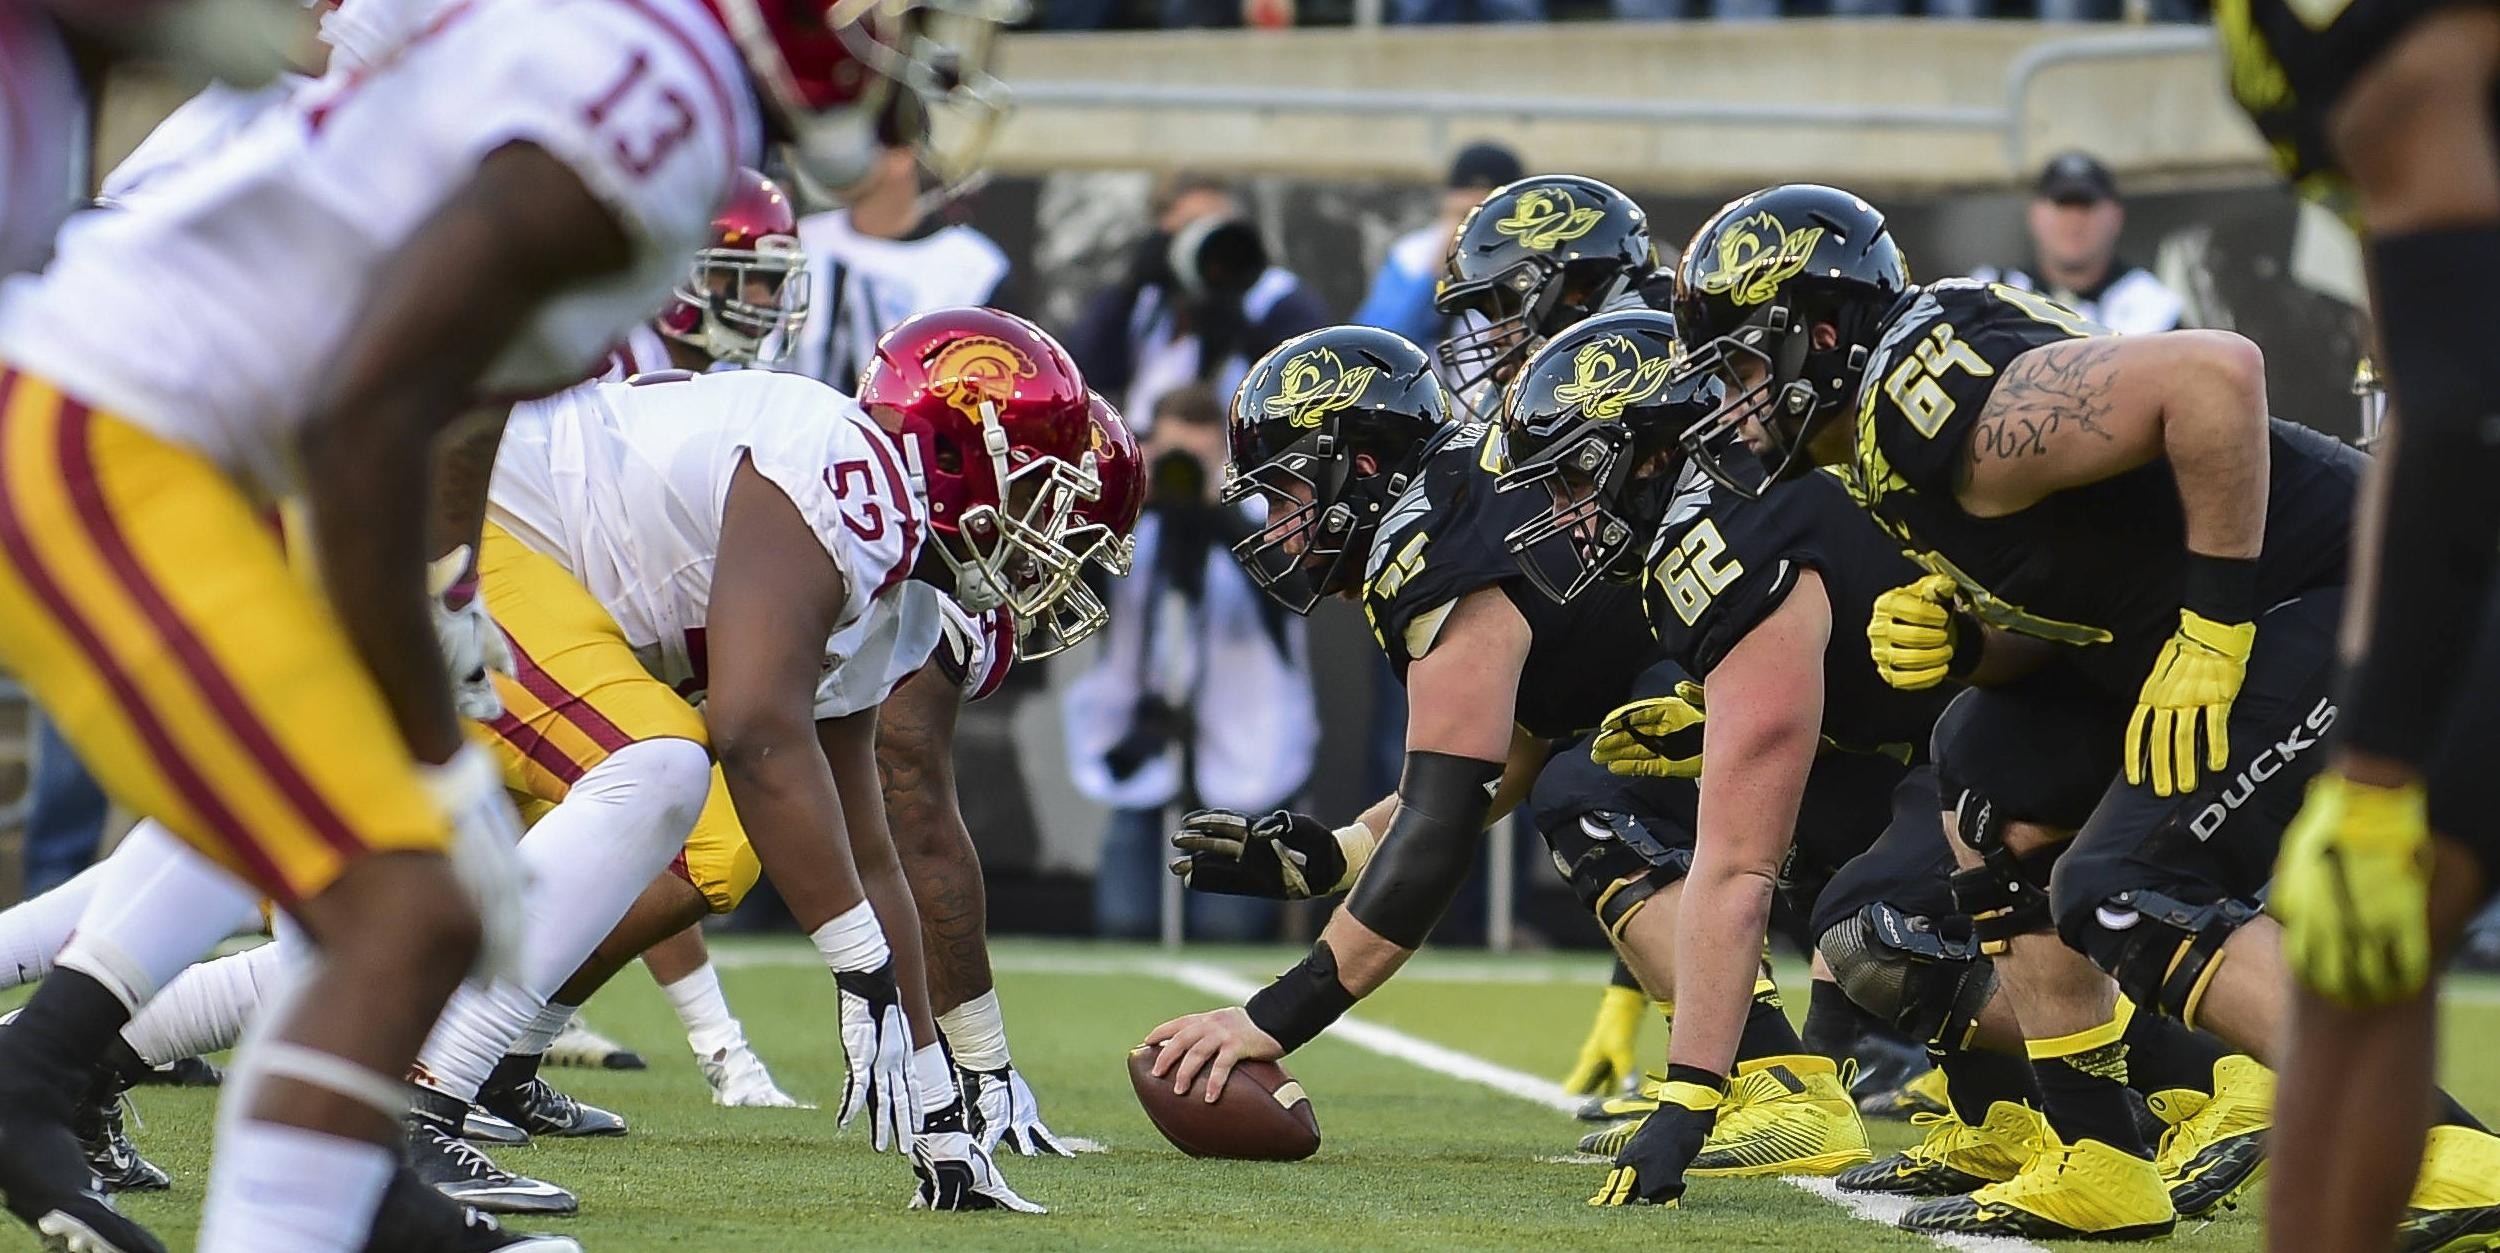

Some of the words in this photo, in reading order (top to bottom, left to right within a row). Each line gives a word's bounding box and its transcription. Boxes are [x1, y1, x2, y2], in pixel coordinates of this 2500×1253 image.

[584, 50, 696, 178] 13
[1884, 322, 1995, 440] 64
[1653, 516, 1744, 627] 62
[2189, 696, 2339, 843] DUCKS
